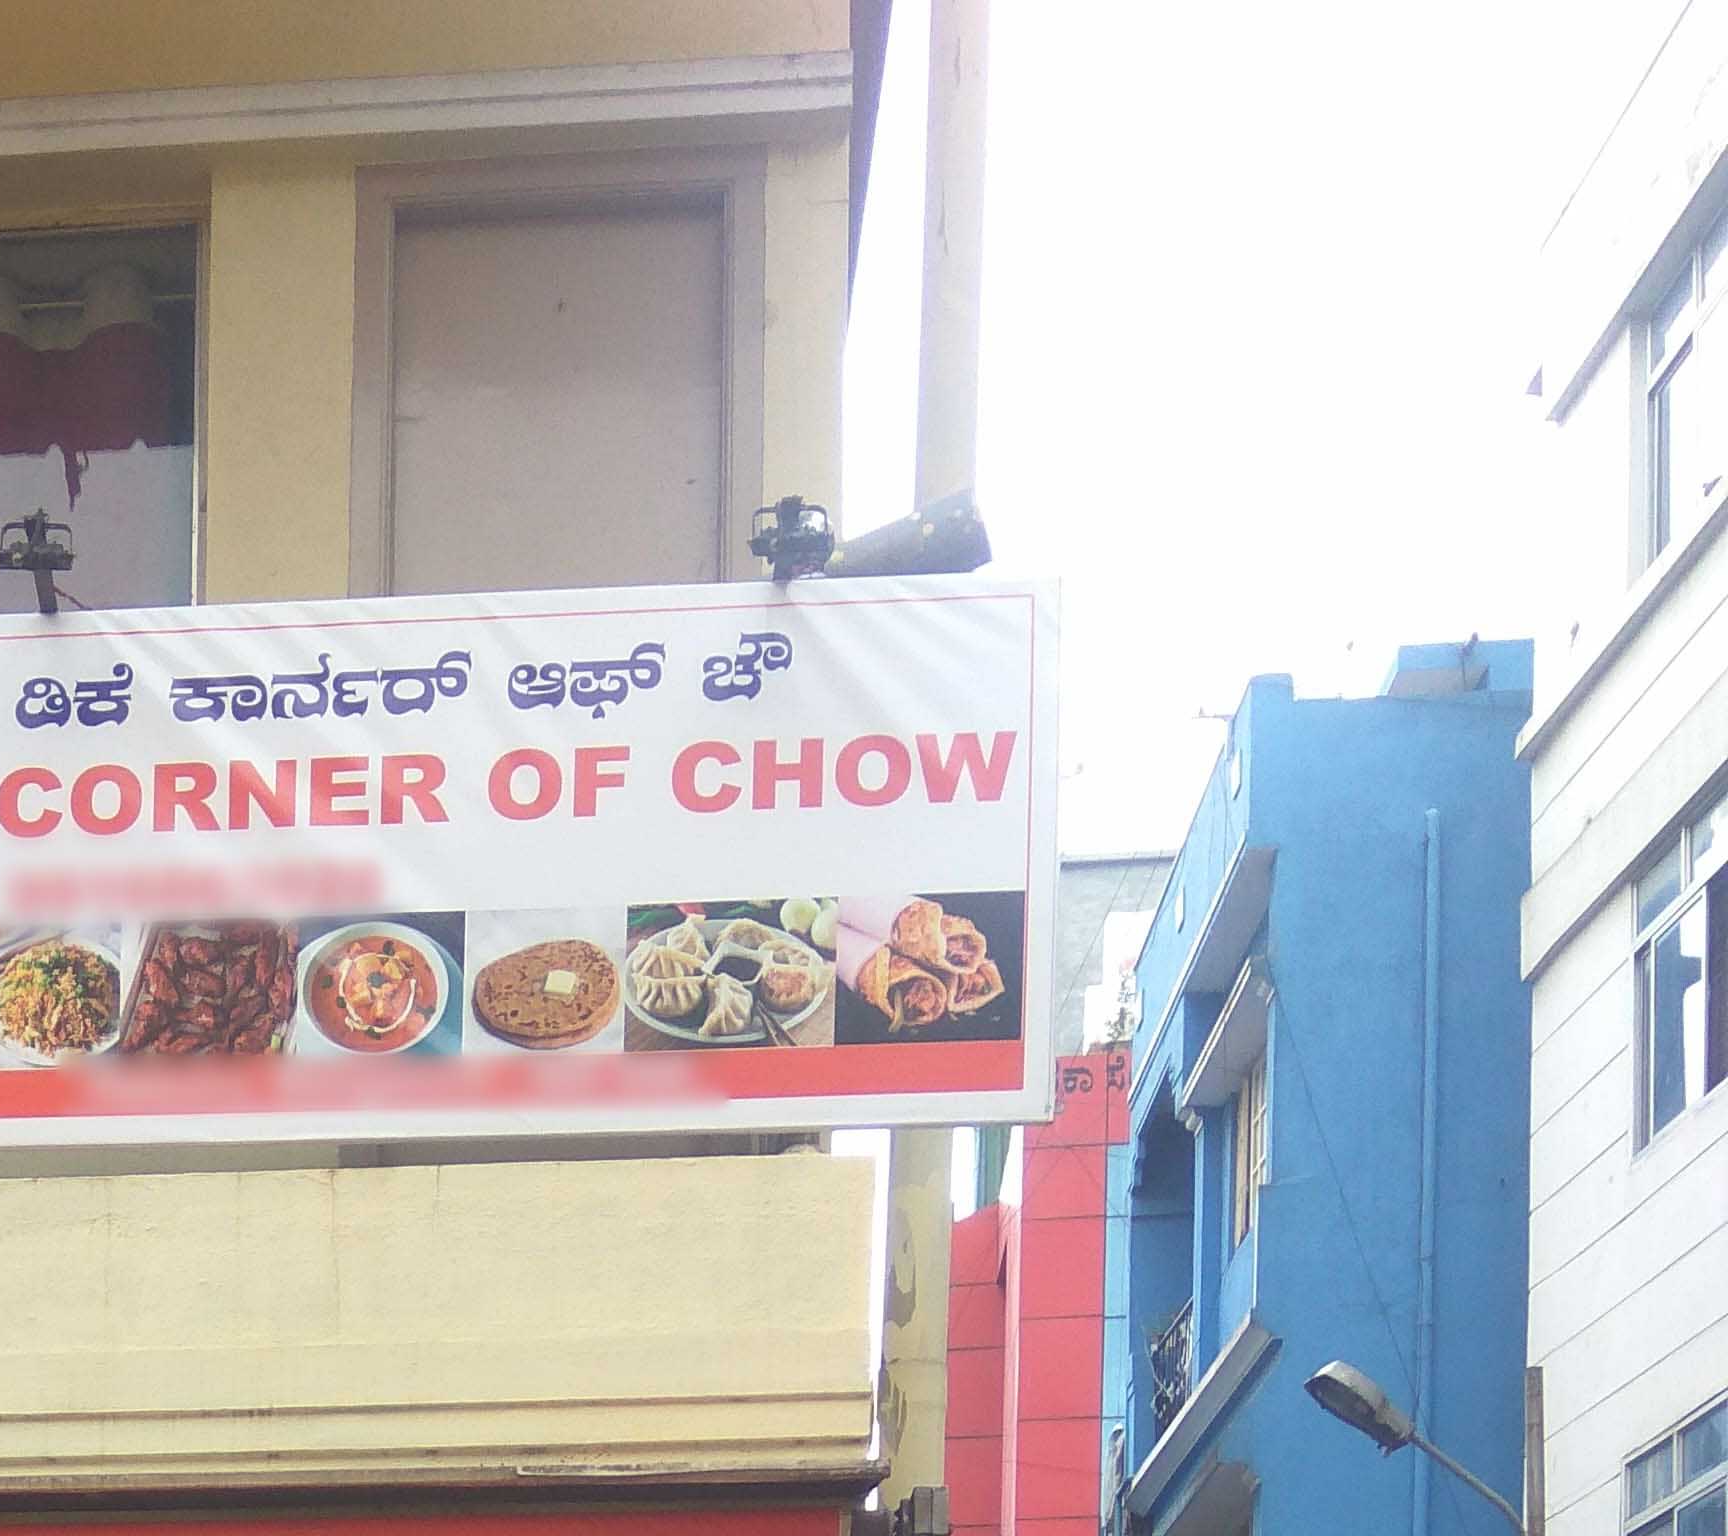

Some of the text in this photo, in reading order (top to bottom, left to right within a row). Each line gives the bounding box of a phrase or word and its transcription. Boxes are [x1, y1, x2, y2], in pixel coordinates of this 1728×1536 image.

[15, 663, 133, 729] ಡಿಕೆ
[169, 651, 472, 721] ಕಾರ್ನರ್
[507, 643, 666, 719] ಆಫ್
[488, 746, 630, 820] OF
[671, 732, 1017, 812] CHOW
